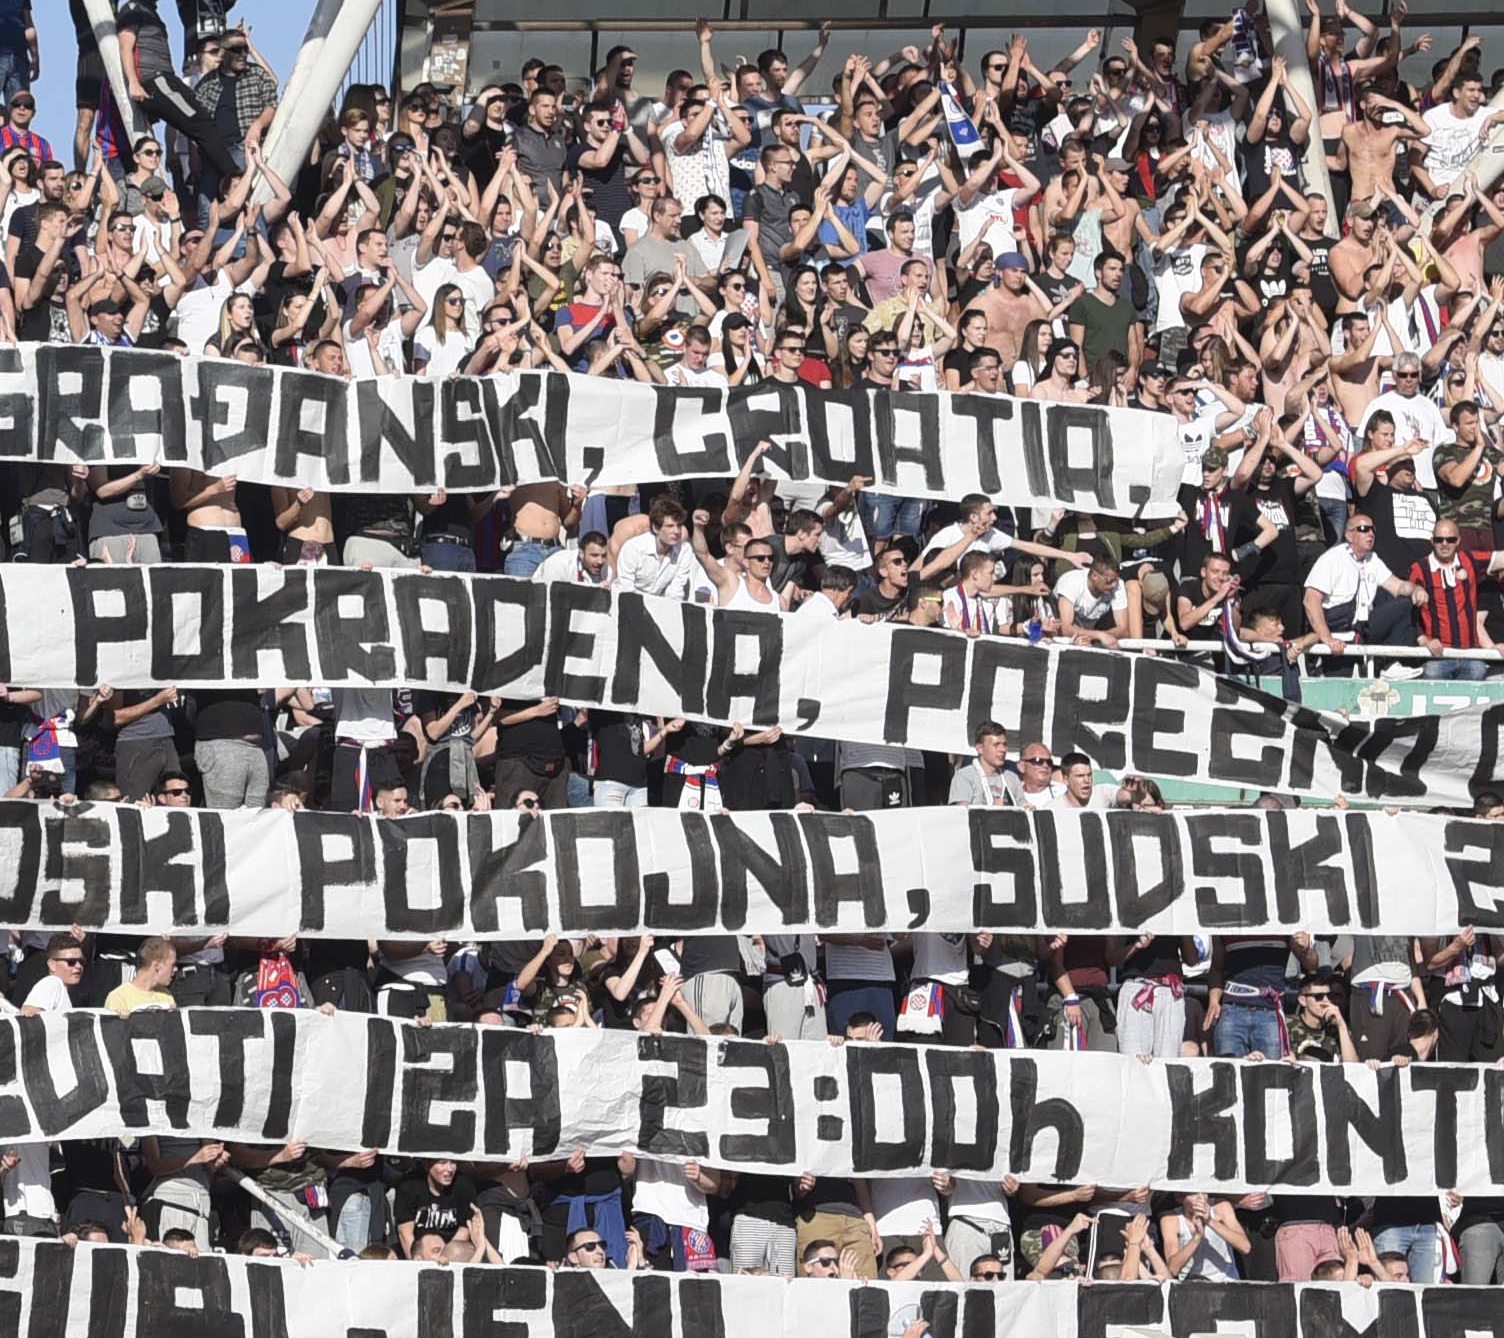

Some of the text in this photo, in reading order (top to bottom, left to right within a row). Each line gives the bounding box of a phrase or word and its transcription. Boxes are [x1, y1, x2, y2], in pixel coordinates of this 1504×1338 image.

[74, 566, 821, 732] POKRADENA,
[296, 805, 930, 931] POKOJNA,
[972, 806, 1379, 929] SUDSKI
[360, 1018, 562, 1156] IZA
